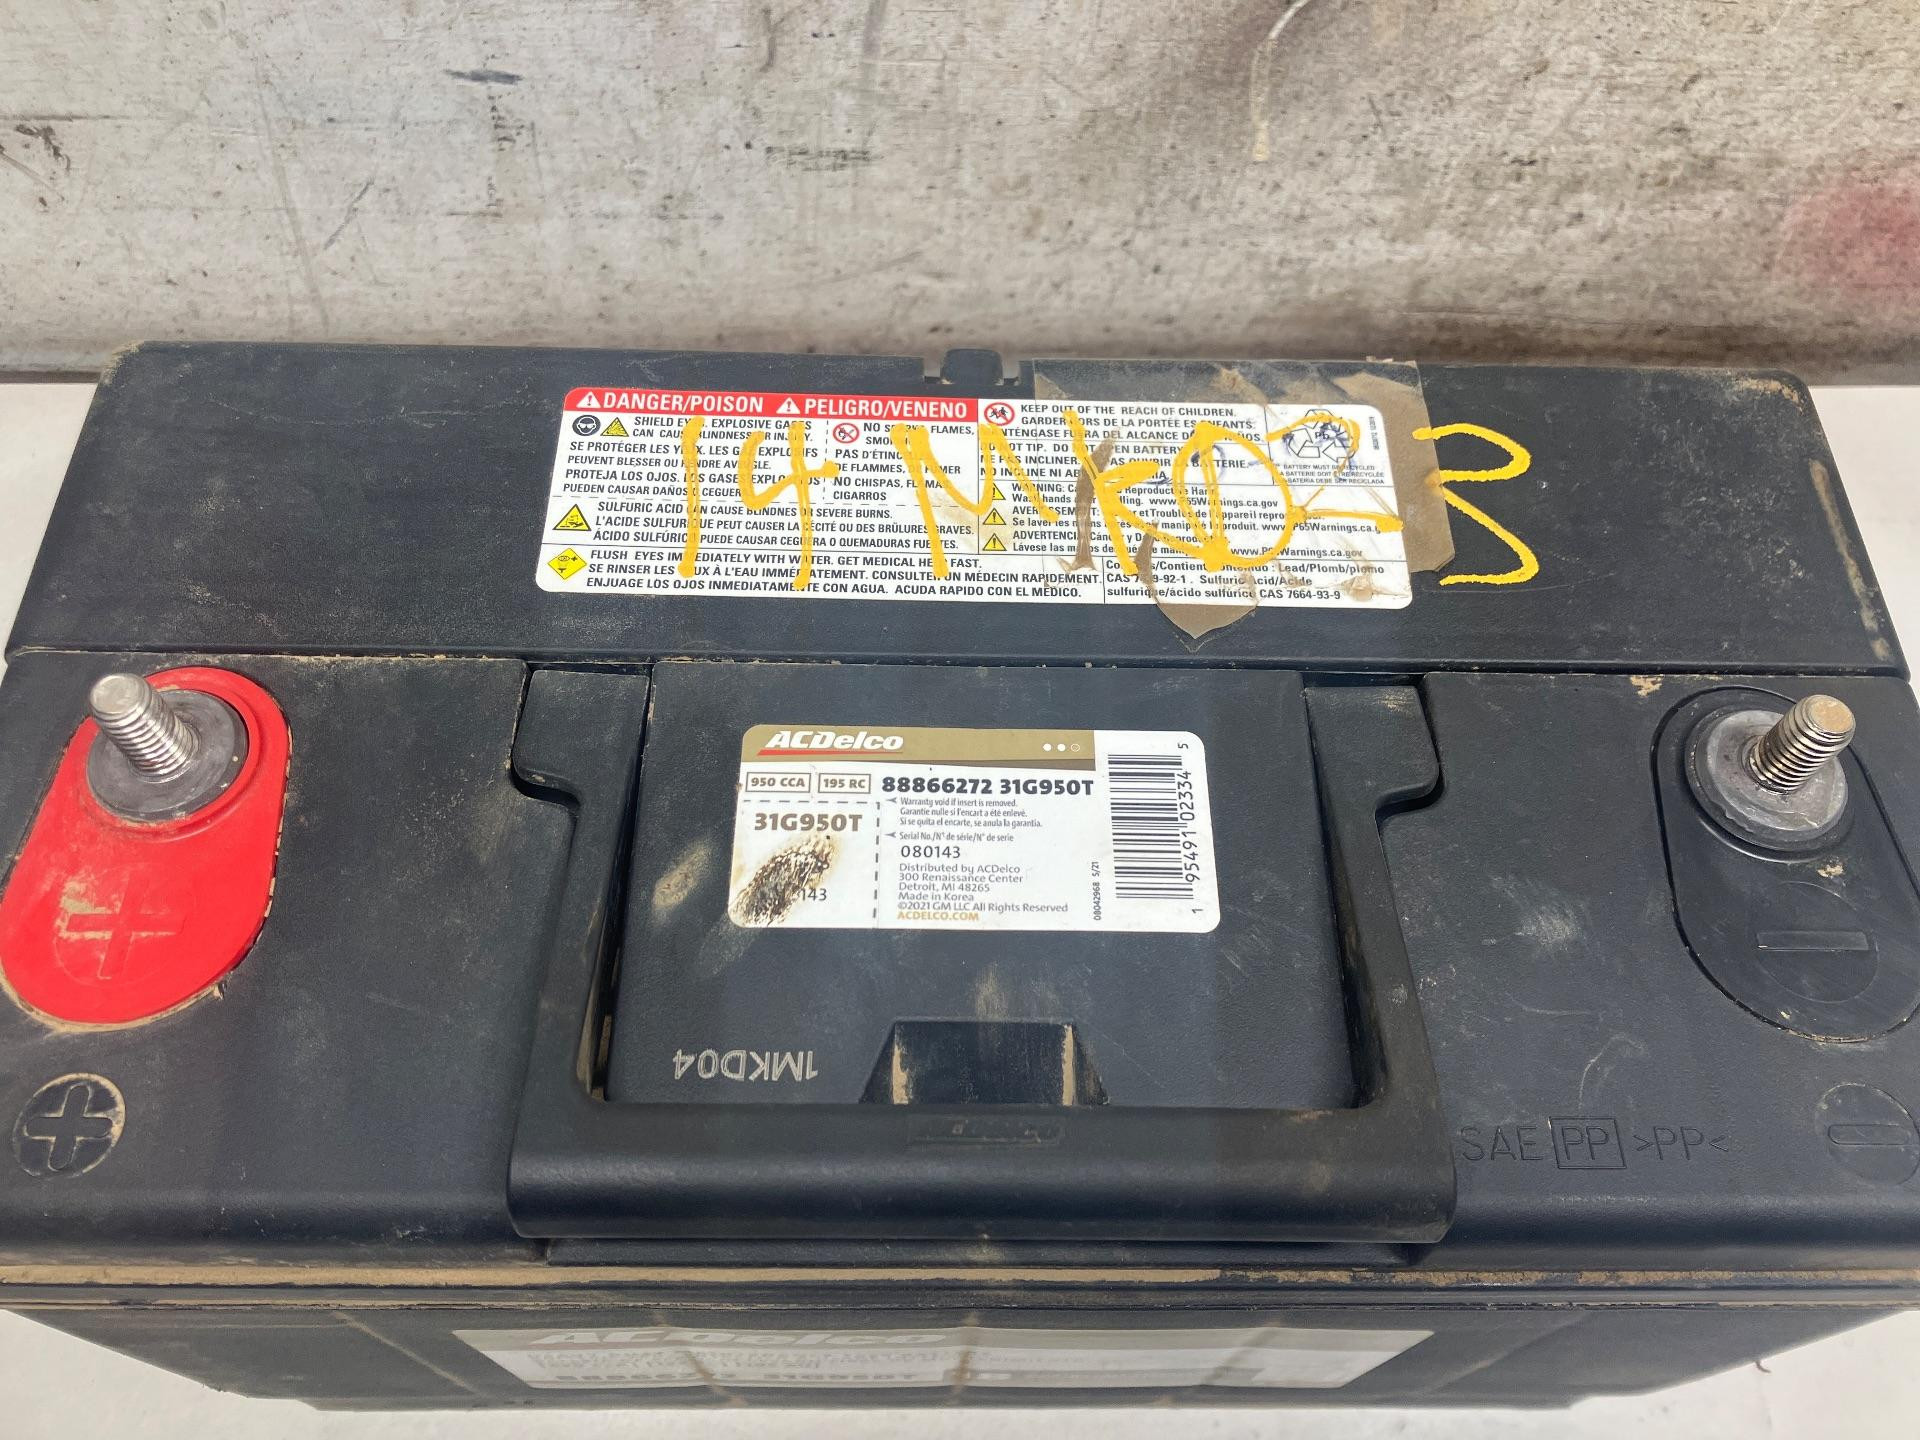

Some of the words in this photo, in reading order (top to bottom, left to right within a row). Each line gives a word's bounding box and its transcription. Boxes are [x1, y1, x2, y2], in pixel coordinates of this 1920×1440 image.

[603, 392, 764, 413] DANGER/POISON
[804, 398, 967, 418] PELIGRO/VENENO
[1020, 404, 1049, 413] KEEP
[1077, 405, 1094, 414] OF
[1095, 406, 1116, 415] THE
[1121, 406, 1158, 415] REACH
[1161, 407, 1176, 416] OF
[1178, 407, 1237, 417] CHILDREN.
[634, 416, 674, 427] SHIELD
[711, 418, 772, 429] EXPLOSIVE
[1021, 416, 1067, 425] GARDER
[1103, 418, 1118, 427] DE
[1121, 418, 1135, 427] LA
[1138, 417, 1181, 428] PORTÉE
[633, 428, 654, 438] CAN
[863, 422, 881, 432] NO
[930, 425, 975, 436] FLAMES,
[1126, 431, 1178, 440] ALCANCE
[569, 441, 585, 451] SE
[587, 440, 647, 453] PROTÉGER
[649, 444, 670, 454] LES
[709, 446, 729, 456] LES
[835, 449, 859, 459] PAS
[1025, 443, 1047, 453] TIP.
[1053, 444, 1069, 453] DO
[567, 455, 615, 465] PEUVENT
[617, 457, 661, 467] BLESSER
[664, 459, 679, 468] OU
[850, 463, 906, 474] FLAMMES,
[1049, 468, 1062, 478] NI
[565, 468, 618, 480] PROTEJA
[621, 470, 644, 481] LOS
[646, 472, 680, 483] OJOS.
[833, 477, 852, 487] NO
[854, 478, 904, 489] CHISPAS,
[563, 483, 606, 494] PUEDEN
[607, 485, 650, 495] CAUSAR
[652, 484, 688, 496] DAÑOS
[833, 490, 887, 501] CIGARROS
[1042, 494, 1072, 503] hands
[597, 501, 653, 513] SULFURIC
[655, 503, 684, 514] ACID
[710, 505, 744, 516] CAUSE
[816, 507, 853, 518] SEVERE
[855, 509, 893, 519] BURNS.
[595, 515, 641, 527] L'ACIDE
[716, 520, 743, 530] PEUT
[745, 521, 785, 531] CAUSER
[787, 522, 800, 531] LA
[839, 523, 853, 533] OU
[856, 523, 875, 533] DES
[1012, 517, 1025, 527] Se
[593, 528, 630, 541] ÁCIDO
[700, 534, 733, 544] PUEDE
[736, 535, 778, 545] CAUSAR
[829, 537, 837, 547] O
[839, 538, 911, 548] QUEMADURAS
[1012, 542, 1047, 552] Lávese
[1049, 543, 1065, 552] las
[591, 549, 628, 560] FLUSH
[634, 551, 665, 561] EYES
[667, 552, 752, 563] IMEDIATELY
[754, 554, 786, 564] WITH
[837, 556, 860, 566] GET
[862, 557, 916, 567] MEDICAL
[950, 558, 983, 569] FAST.
[588, 563, 604, 573] SE
[606, 564, 651, 574] RINSER
[653, 565, 675, 575] LES
[712, 564, 722, 576] À
[724, 567, 759, 577] L'EAU
[964, 570, 1019, 583] MÉDECIN
[1021, 573, 1103, 584] RAPIDEMENT.
[1106, 572, 1131, 583] CAS
[586, 577, 645, 588] ENJUAGE
[646, 578, 670, 589] LOS
[673, 579, 705, 590] OJOS
[822, 583, 848, 593] CON
[851, 583, 889, 595] AGUA.
[894, 584, 937, 595] ACUDA
[939, 585, 984, 596] RAPIDO
[987, 586, 1013, 597] CON
[1015, 587, 1030, 597] EL
[1259, 589, 1284, 599] CAS
[1286, 589, 1341, 600] 7664-93-9
[764, 730, 904, 750] ACDelco
[750, 777, 776, 788] 950
[780, 777, 806, 788] CCA
[823, 778, 845, 789] 195
[849, 779, 867, 789] RC
[881, 776, 993, 794] 88866272
[1000, 778, 1095, 796] 31G950T
[1177, 771, 1195, 821] 02334
[900, 797, 934, 807] Warranty
[934, 798, 950, 807] void
[950, 798, 957, 807] if
[957, 799, 977, 807] insert
[978, 799, 984, 807] is
[985, 799, 1018, 808] removed.
[900, 807, 930, 816] Garantie
[931, 808, 950, 816] nulle
[950, 808, 956, 816] si
[754, 812, 863, 832] 31G950T
[900, 818, 907, 826] Si
[917, 818, 935, 828] quita
[936, 818, 943, 826] el
[944, 819, 974, 828] encarte,
[983, 820, 1003, 828] anula
[899, 831, 920, 841] Serial
[946, 833, 955, 841] de
[986, 834, 996, 842] de
[900, 845, 961, 859] 080143
[1181, 831, 1201, 883] 95491
[899, 863, 958, 873] Distributed
[961, 864, 974, 875] by
[977, 865, 1021, 874] ACDelco
[1091, 861, 1100, 877] 5/21
[899, 873, 919, 882] 300
[922, 873, 986, 883] Renaissance
[988, 875, 1024, 884] Center
[899, 882, 939, 893] Detroit,
[941, 883, 955, 892] MI
[957, 883, 990, 893] 48265
[898, 892, 928, 901] Made
[931, 892, 942, 901] in
[944, 893, 975, 902] Korea
[932, 902, 952, 911] GM
[952, 902, 970, 911] LLC
[972, 902, 986, 912] All
[988, 903, 1021, 914] Rights
[1023, 903, 1069, 913] Reserved
[896, 911, 980, 922] ACDELCO.COM
[672, 1048, 819, 1083] 1MKD04
[1460, 1126, 1544, 1161] SAE
[1560, 1126, 1610, 1161] PP
